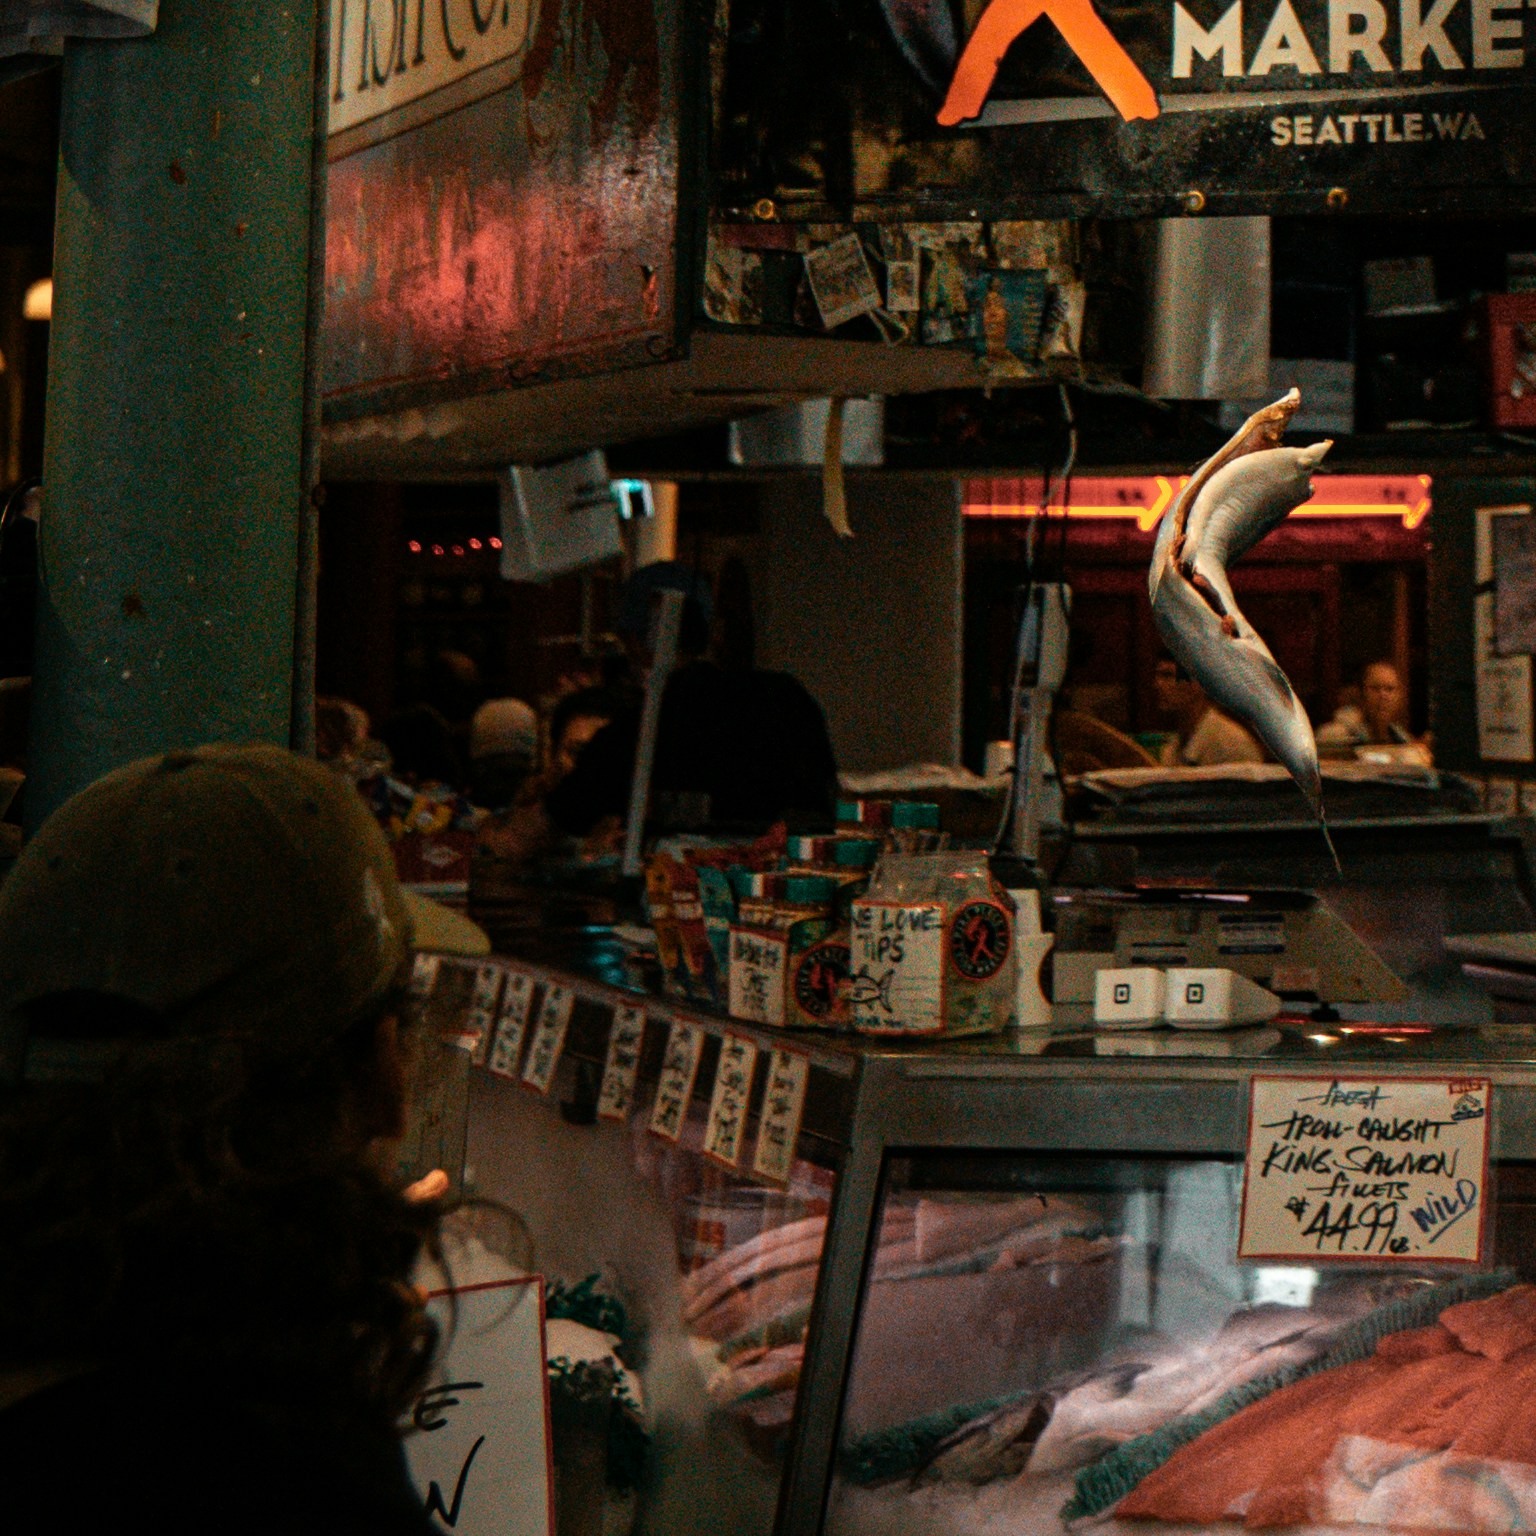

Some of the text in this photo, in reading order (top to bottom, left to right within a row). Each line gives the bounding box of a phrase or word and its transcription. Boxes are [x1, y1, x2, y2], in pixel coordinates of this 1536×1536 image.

[857, 932, 906, 963] TIPS
[1261, 1110, 1458, 1144] TROLL-CAUGHT
[1332, 1145, 1460, 1179] SALMON
